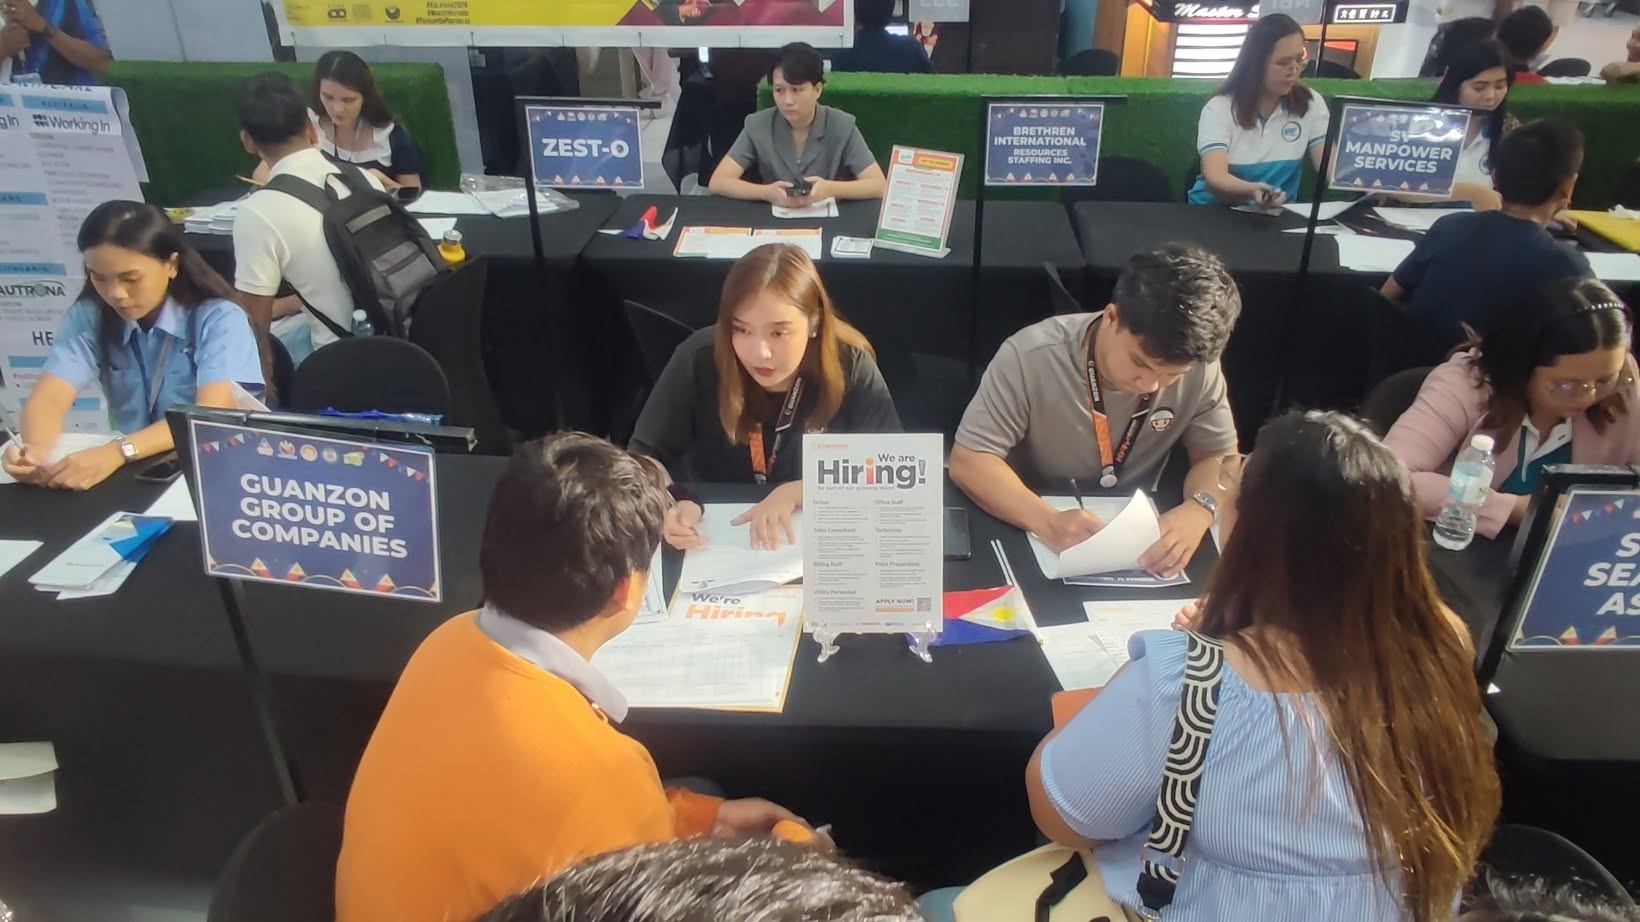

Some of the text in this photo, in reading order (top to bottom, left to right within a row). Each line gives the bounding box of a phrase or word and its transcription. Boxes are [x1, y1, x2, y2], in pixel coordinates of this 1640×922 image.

[1174, 3, 1245, 18] Master
[1013, 126, 1075, 136] BRETHREN
[1390, 130, 1410, 142] SV
[541, 138, 629, 158] ZEST-O
[994, 137, 1086, 146] INTERNATIONAL
[1013, 148, 1068, 156] RESOURCES
[1345, 141, 1453, 160] MANPOWER
[1008, 156, 1051, 164] STAFFING
[1353, 156, 1438, 173] SERVICES
[878, 454, 915, 463] We are
[818, 456, 926, 489] Hiring!
[240, 473, 390, 511] GUANZON
[240, 497, 395, 534] GROUP OF
[231, 519, 408, 559] COMPANIES
[692, 593, 741, 605] We're
